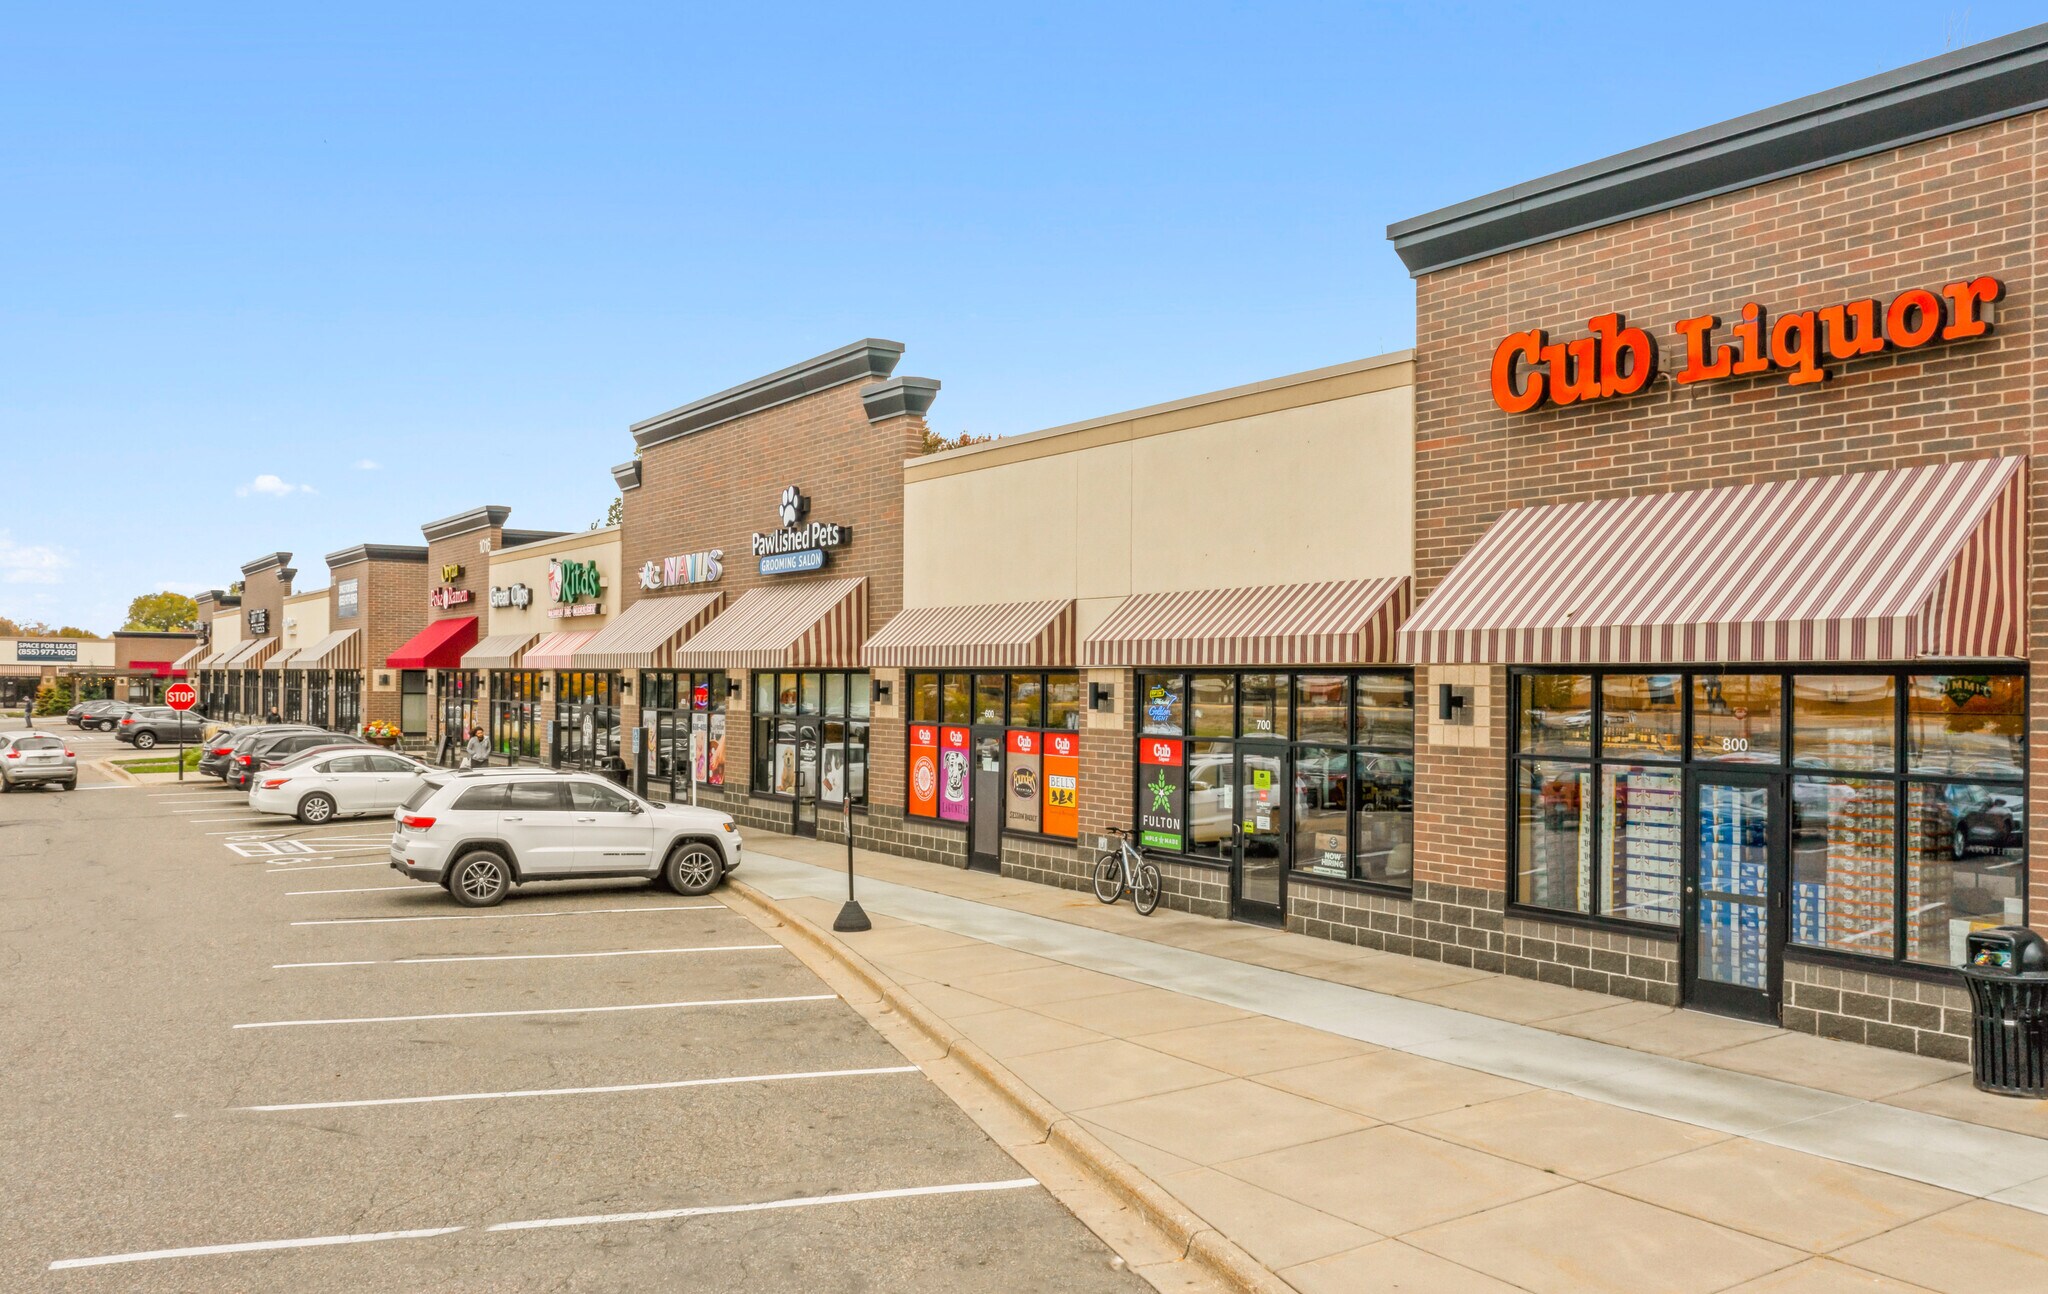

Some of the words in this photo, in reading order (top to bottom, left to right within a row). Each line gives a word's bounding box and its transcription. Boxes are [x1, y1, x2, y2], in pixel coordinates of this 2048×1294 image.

[1491, 311, 1656, 414] Cub
[1675, 276, 2003, 387] Liquor
[752, 525, 810, 556] Pawlished
[811, 521, 840, 548] Pets
[663, 549, 723, 587] NAILS
[761, 557, 797, 572] GROOMING
[798, 554, 821, 567] SALON
[562, 559, 599, 603] Rita's
[448, 587, 469, 605] Ramen
[490, 586, 510, 609] Great
[18, 648, 40, 656] (855)
[168, 691, 195, 703] STOP
[984, 709, 995, 718] 600
[1256, 719, 1271, 730] 700
[919, 729, 931, 741] Cub
[950, 730, 963, 743] Cub
[1017, 735, 1032, 747] Cub
[1055, 737, 1070, 750] Cub
[1153, 743, 1171, 757] Cub
[1722, 737, 1748, 752] 800
[1143, 814, 1180, 830] FULTON
[1324, 851, 1342, 861] NOW
[1321, 858, 1344, 868] HIRING
